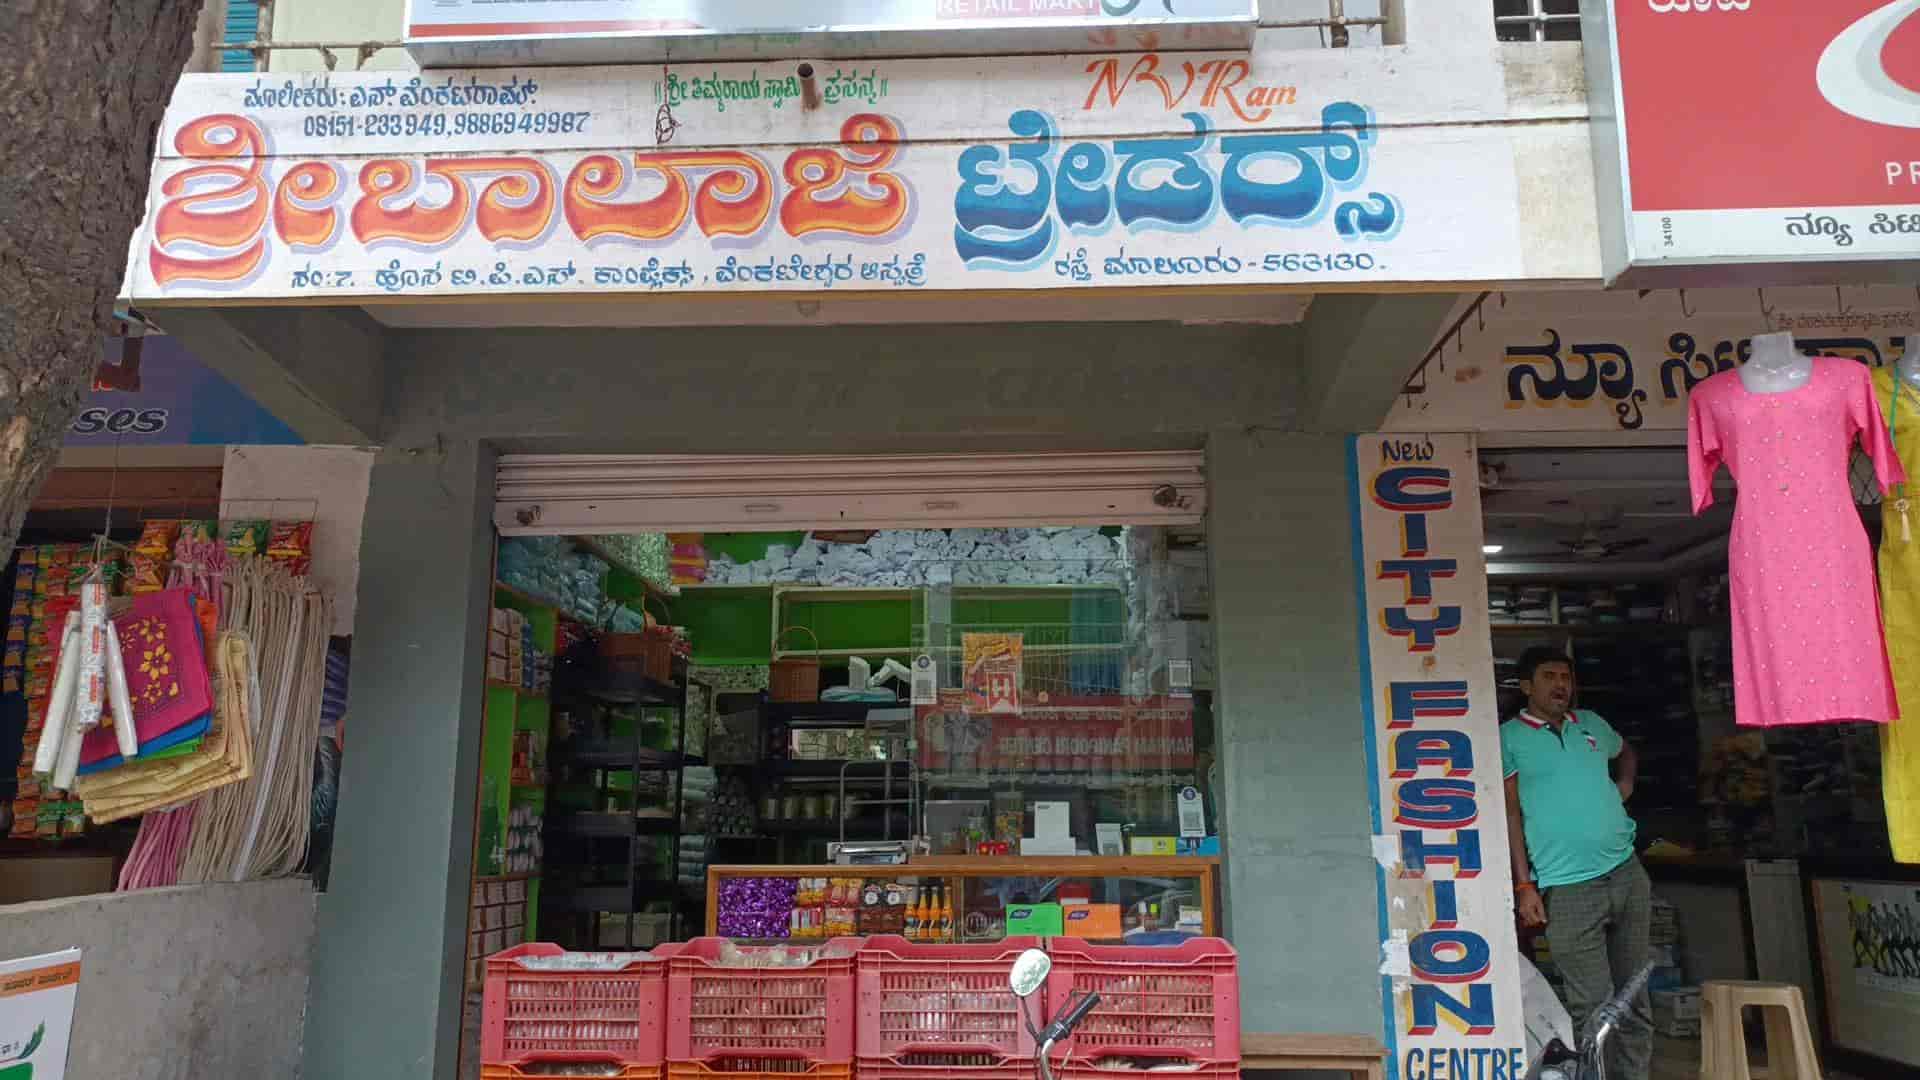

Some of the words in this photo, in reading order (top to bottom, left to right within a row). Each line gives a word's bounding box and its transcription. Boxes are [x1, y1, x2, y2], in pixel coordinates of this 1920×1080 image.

[1661, 216, 1674, 247] 34100
[1784, 211, 1854, 247] ನ್ಯೂ
[1505, 328, 1648, 430] ನ್ಯೂ
[1382, 439, 1435, 462] New
[1368, 466, 1462, 653] CITY
[1384, 680, 1496, 1036] FASHION
[1406, 1047, 1524, 1080] CENTRE
